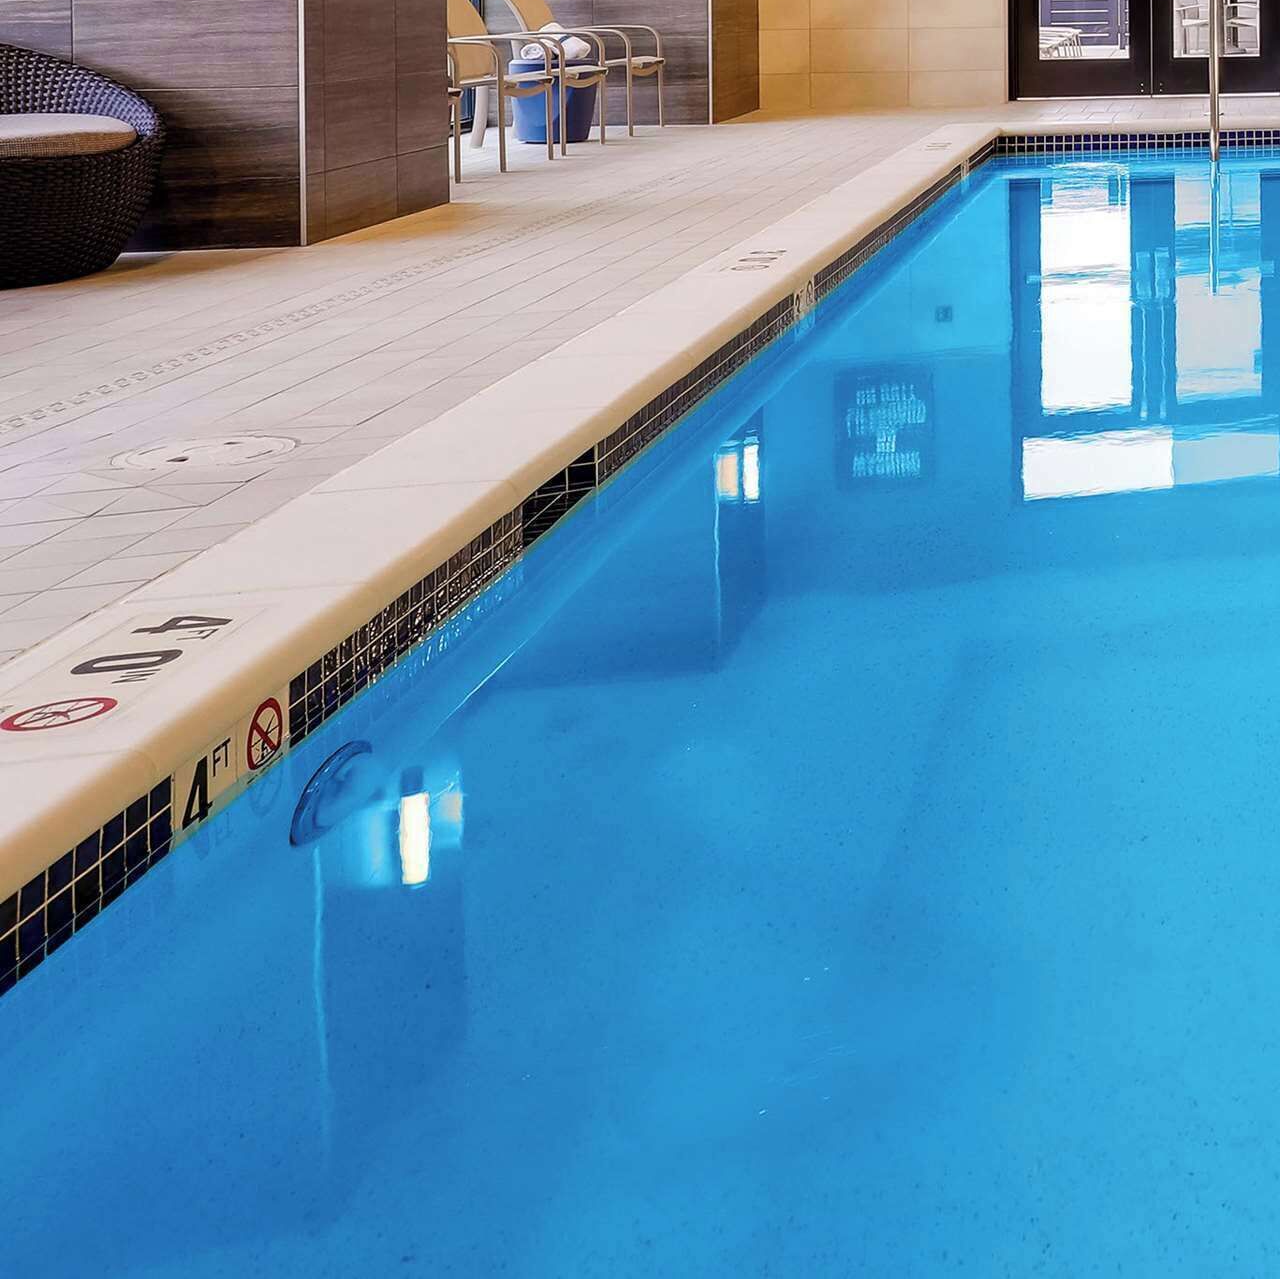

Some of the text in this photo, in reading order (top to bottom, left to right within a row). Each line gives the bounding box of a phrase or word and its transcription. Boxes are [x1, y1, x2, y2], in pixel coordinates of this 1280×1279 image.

[131, 615, 233, 634] 4
[70, 649, 183, 675] 0
[182, 737, 231, 831] 4 FT
